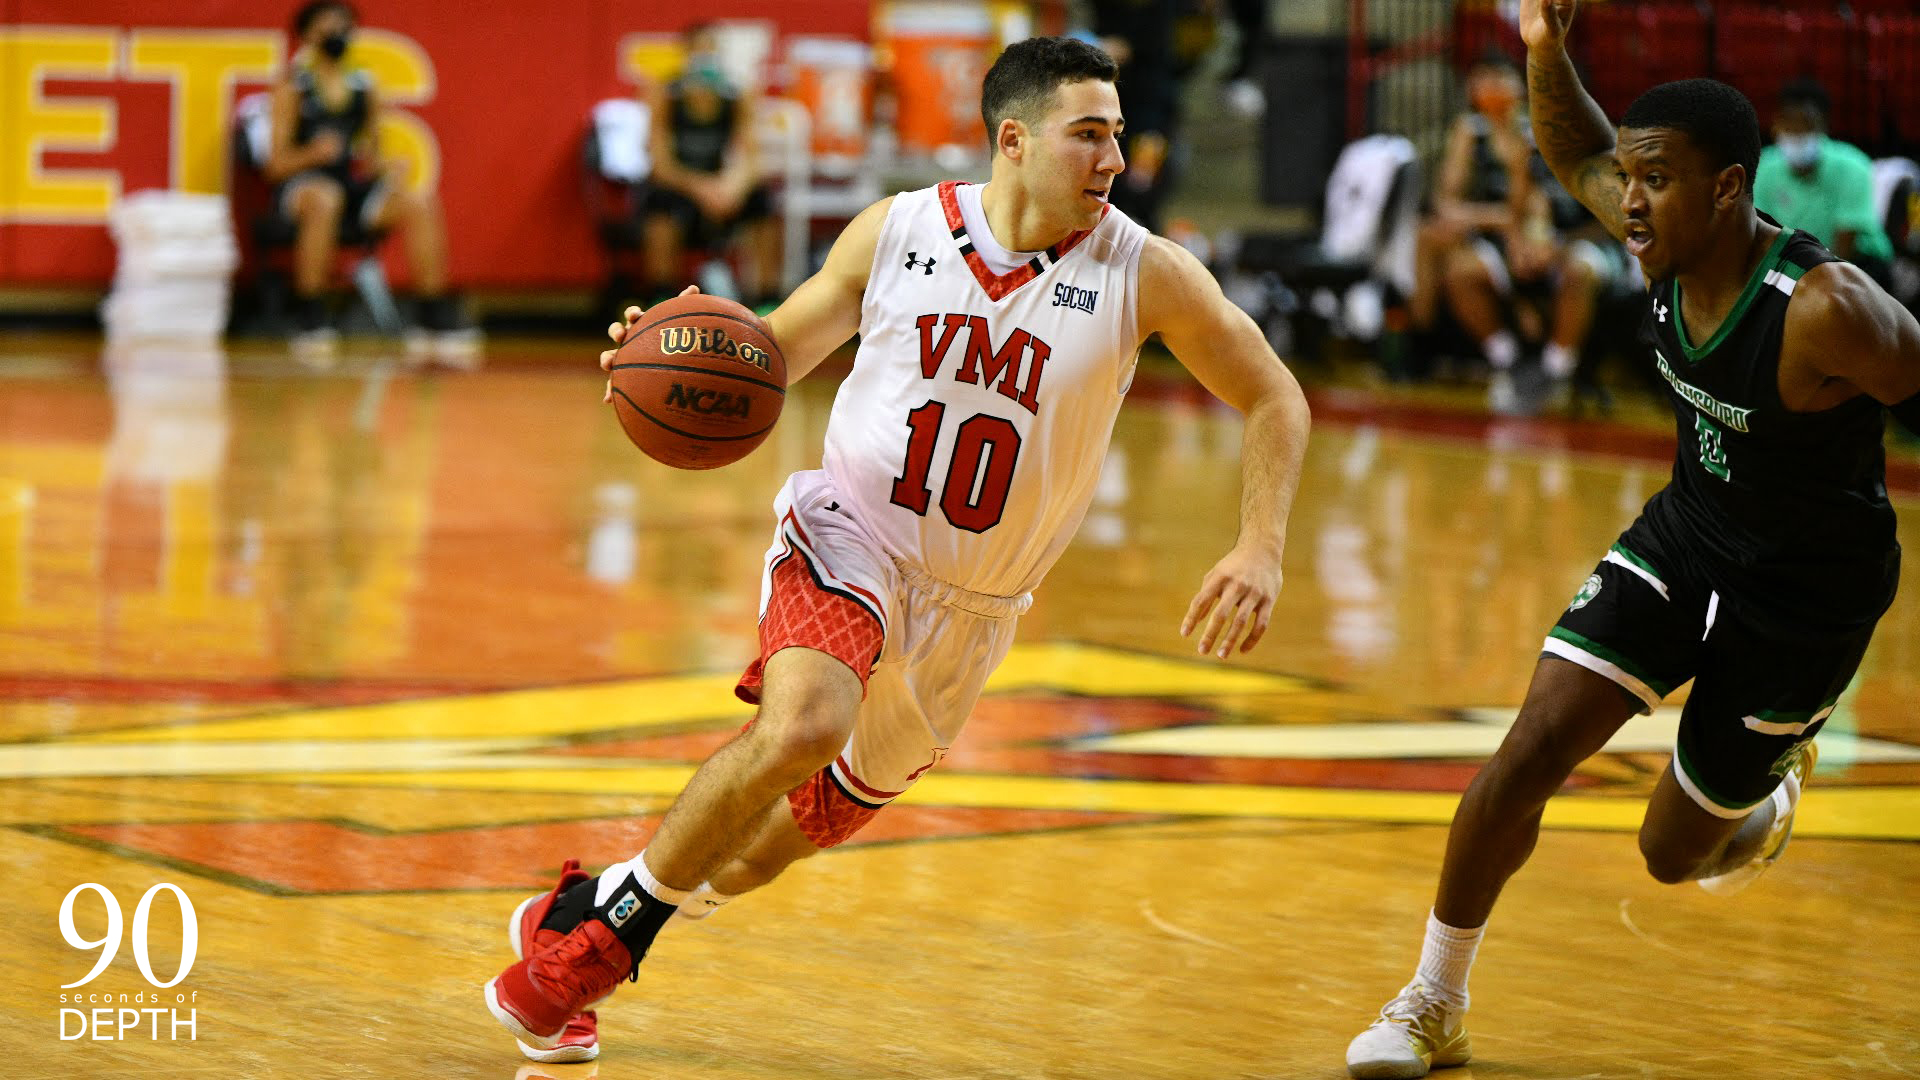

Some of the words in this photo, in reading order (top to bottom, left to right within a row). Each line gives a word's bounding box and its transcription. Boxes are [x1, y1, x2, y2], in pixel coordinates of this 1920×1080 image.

[660, 326, 771, 375] Wilson
[915, 313, 1052, 416] VMI
[664, 382, 752, 417] NCAA
[890, 399, 1022, 534] 10
